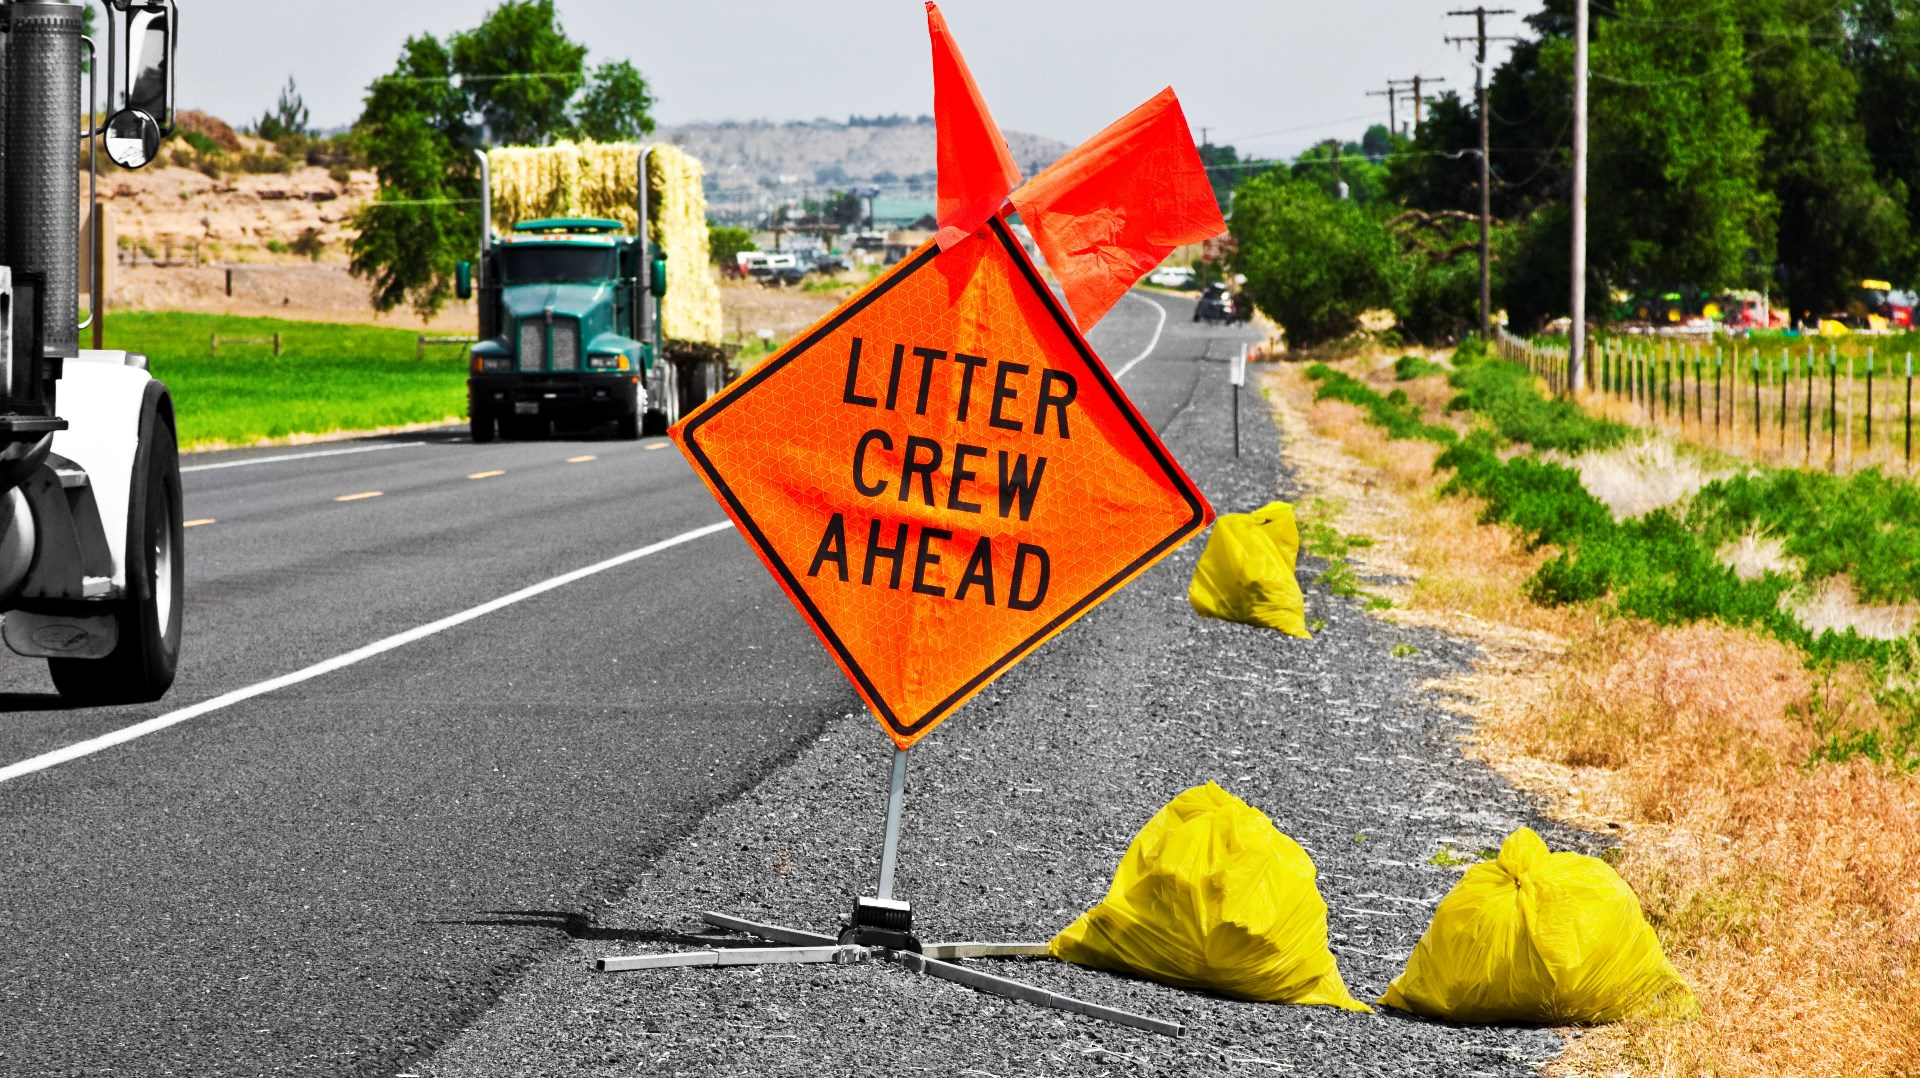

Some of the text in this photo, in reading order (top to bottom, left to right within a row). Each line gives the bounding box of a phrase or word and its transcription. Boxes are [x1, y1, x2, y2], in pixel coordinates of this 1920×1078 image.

[843, 337, 1078, 440] LITTER
[853, 429, 1048, 522] CREW
[807, 512, 1051, 612] AHEAD
